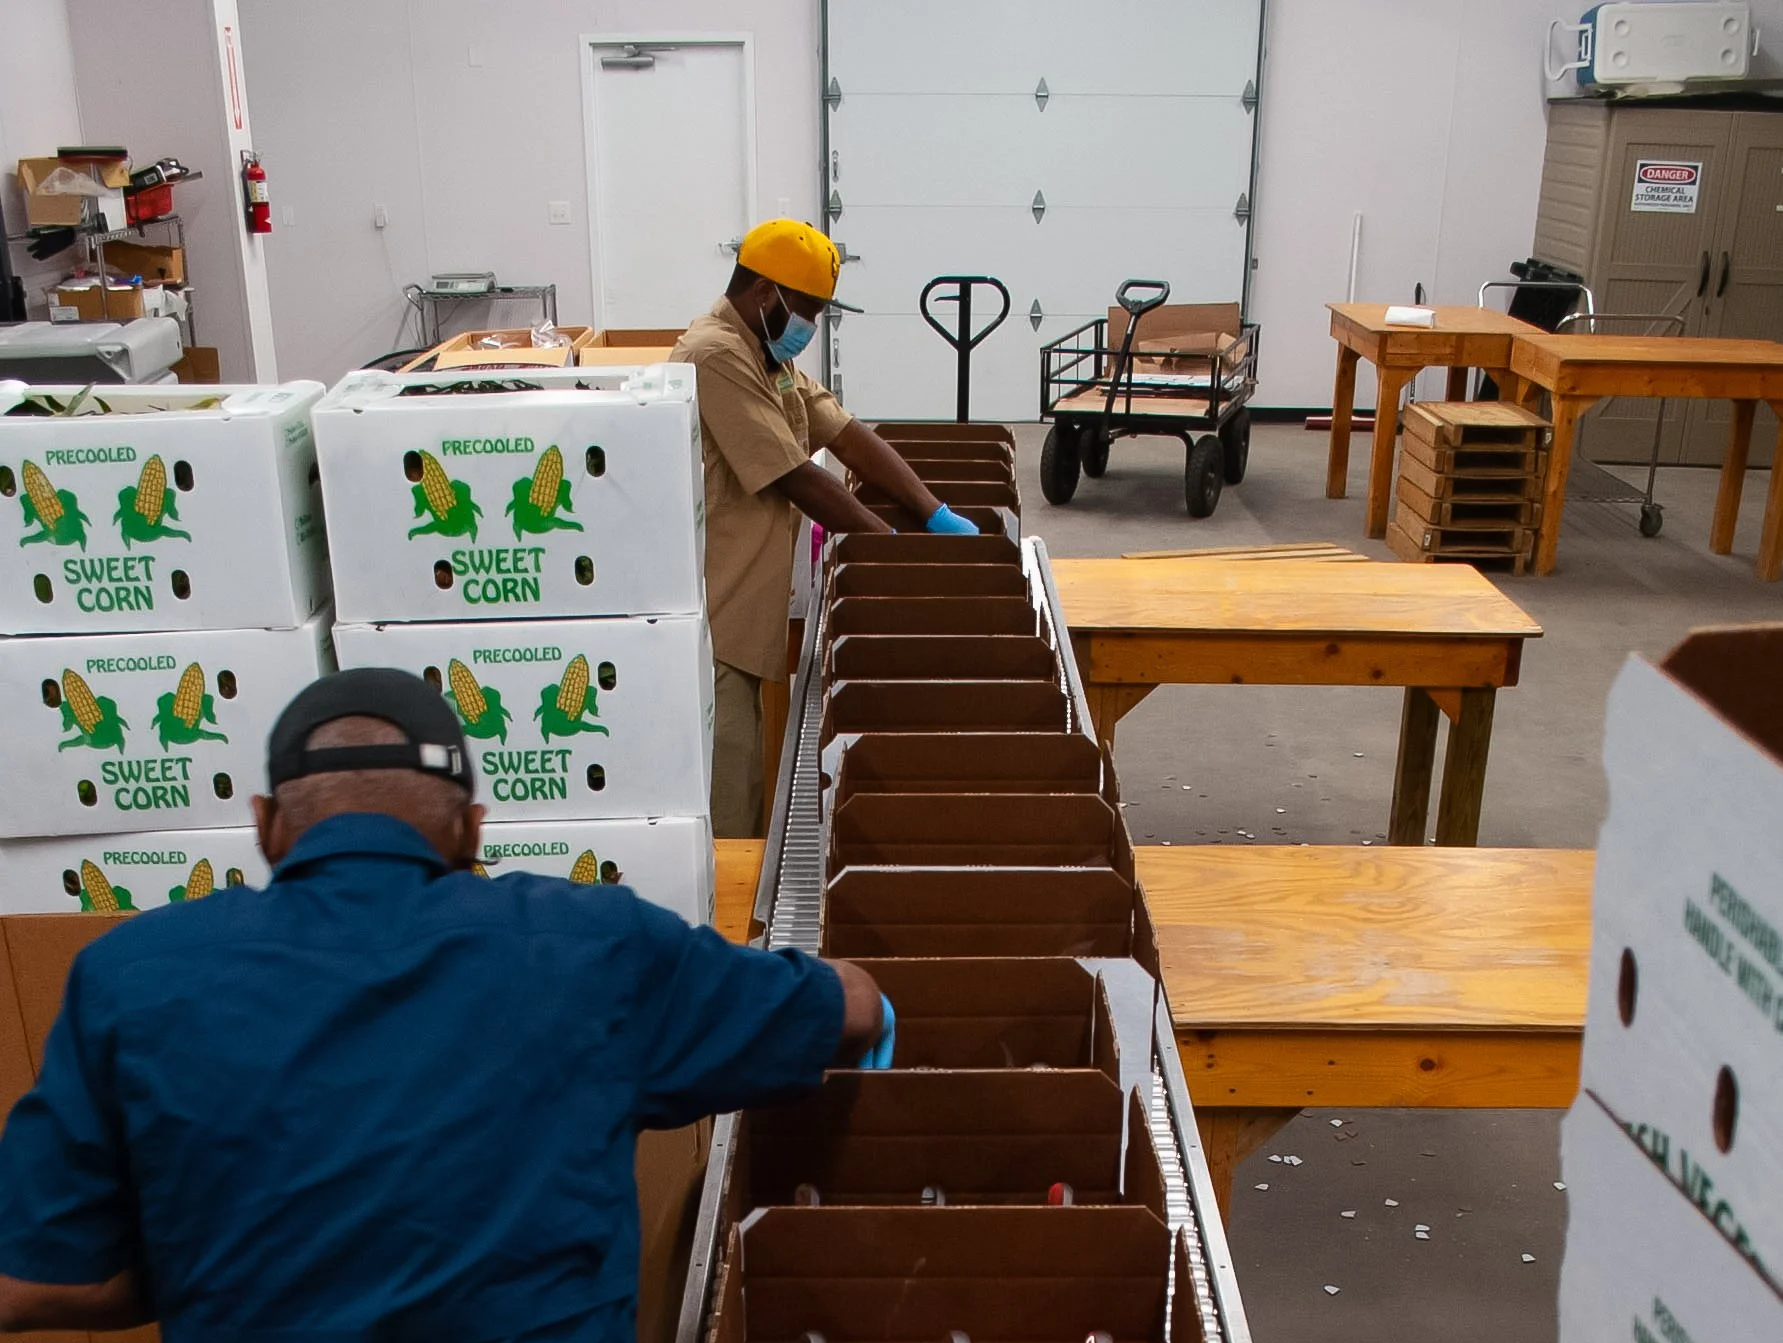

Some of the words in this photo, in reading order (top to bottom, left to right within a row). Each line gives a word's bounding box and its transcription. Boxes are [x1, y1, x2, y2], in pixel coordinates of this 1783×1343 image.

[1646, 168, 1689, 180] DANGER
[1635, 193, 1672, 202] STORAGE
[1672, 195, 1694, 203] AREA
[1645, 185, 1686, 195] CHEMICAL
[45, 446, 138, 465] PRECOOLED
[441, 437, 535, 456] PRECOOLED
[63, 555, 155, 584] SWEET
[451, 546, 547, 576] SWEET
[76, 584, 154, 612] CORN
[462, 576, 541, 604] CORN
[85, 654, 177, 673] PRECOOLED
[471, 645, 562, 664] PRECOOLED
[100, 756, 193, 785] SWEET
[482, 748, 573, 776] SWEET
[113, 785, 191, 811] CORN
[492, 776, 568, 801] CORN
[102, 850, 187, 865] PRECOOLED
[483, 842, 569, 859] PRECOOLED
